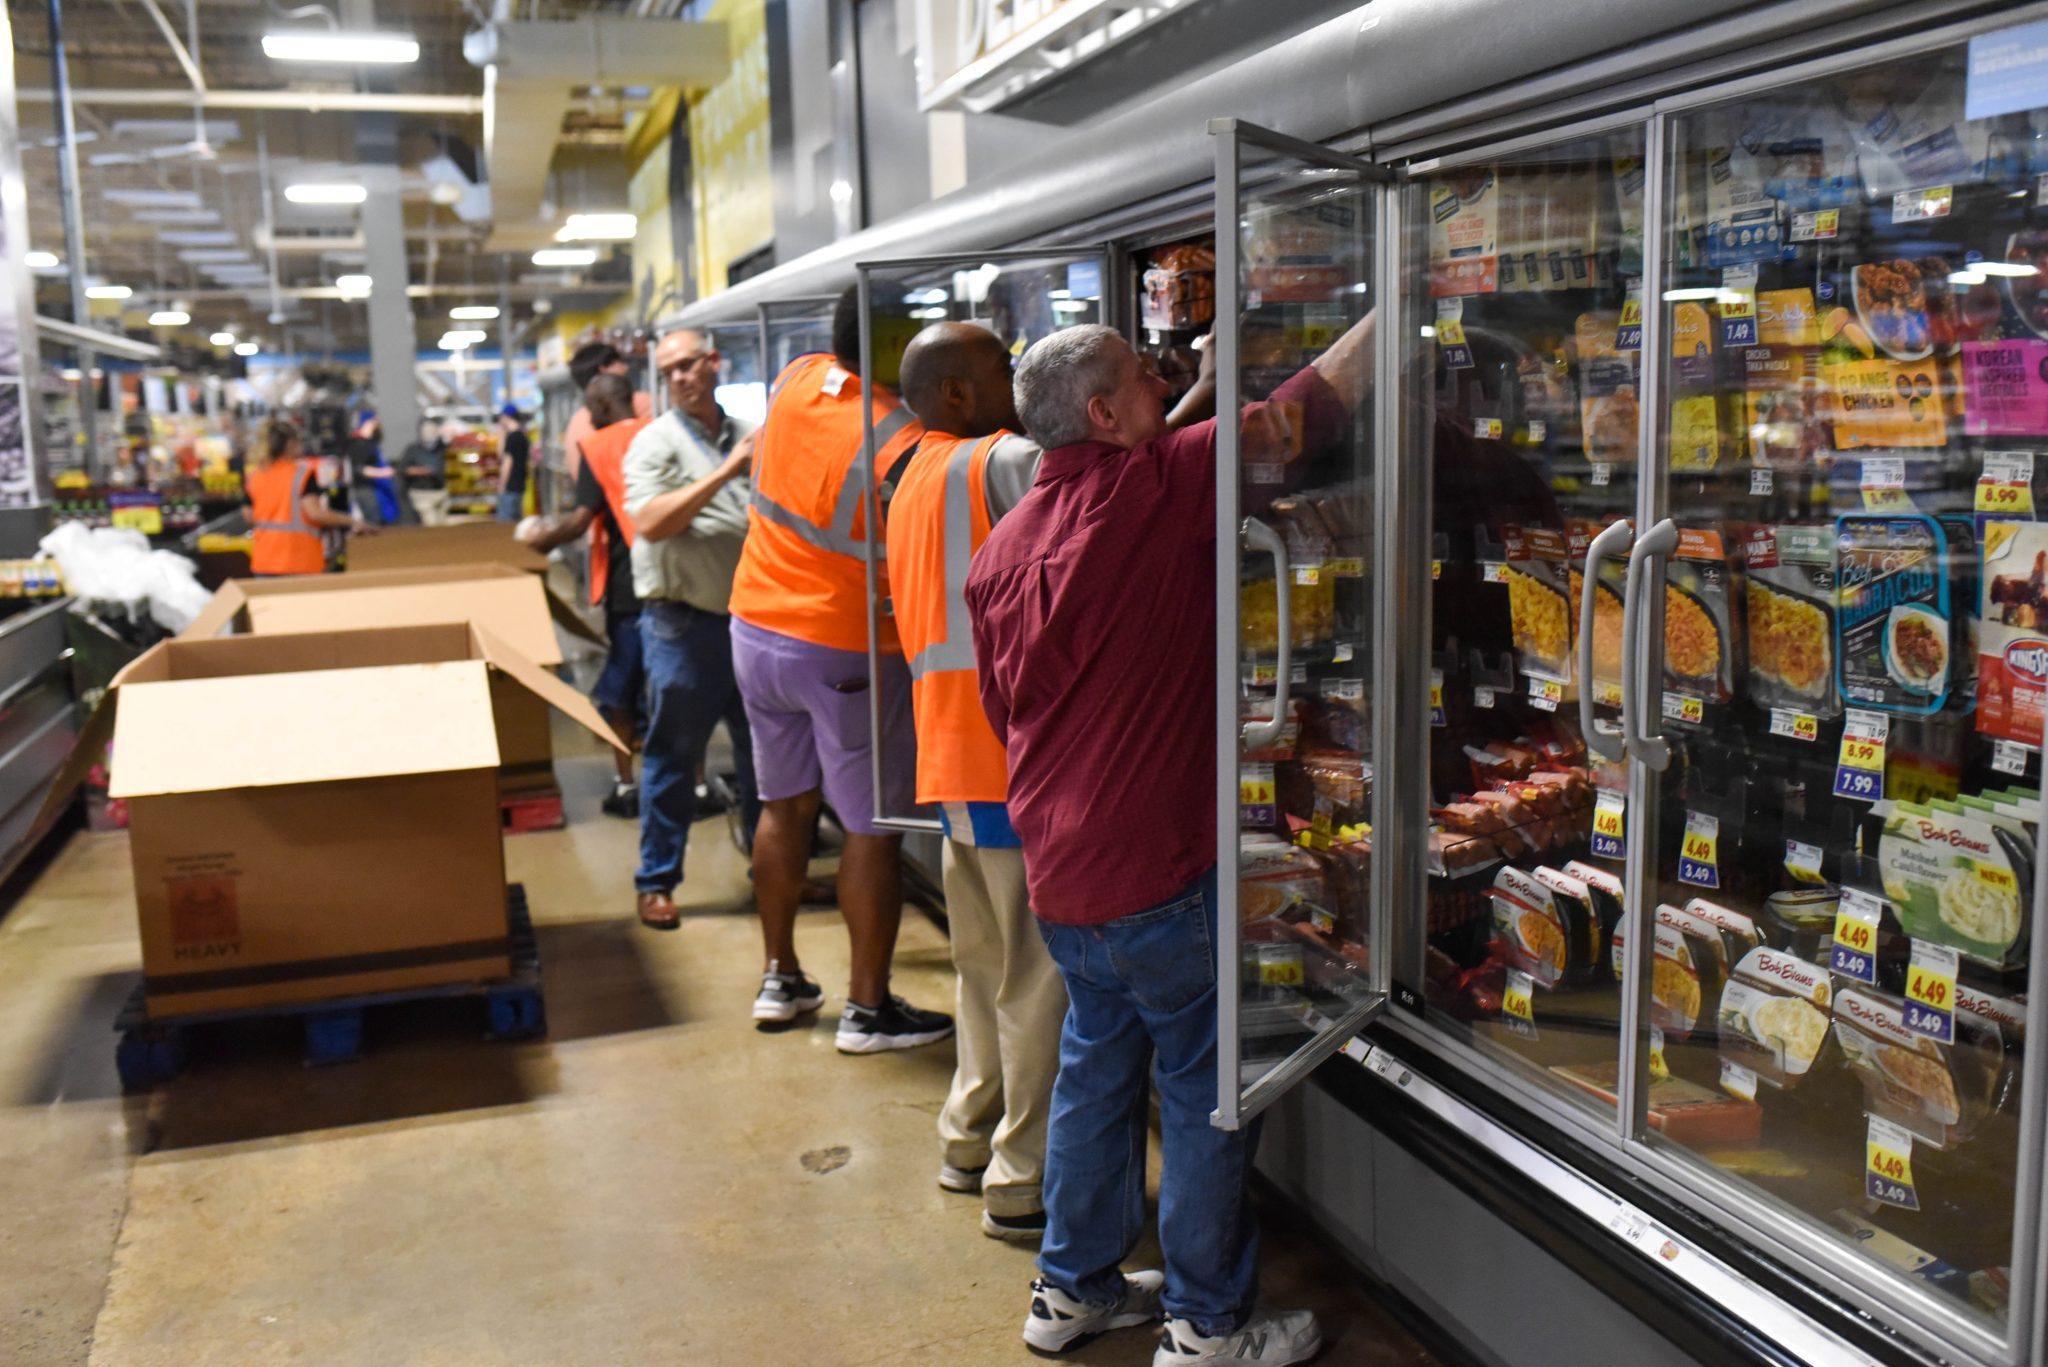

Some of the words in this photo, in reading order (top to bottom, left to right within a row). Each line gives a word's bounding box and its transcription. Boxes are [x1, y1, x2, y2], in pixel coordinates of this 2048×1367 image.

[1619, 331, 1642, 346] 7.49
[1727, 323, 1749, 340] 7.49
[1976, 348, 2023, 367] KOREAN
[1984, 488, 2018, 503] 8.99
[1840, 553, 1873, 588] Beef
[1847, 744, 1874, 760] 8.99
[1843, 773, 1873, 793] 7.99
[1597, 816, 1617, 833] 4.49
[1596, 838, 1618, 854] 3.49
[1918, 820, 1949, 843] Bob
[1949, 829, 1992, 854] Evans
[1687, 841, 1710, 859] 4.49
[1901, 848, 1939, 867] Mashed
[1685, 864, 1710, 881] 3.49
[1891, 859, 1948, 882] Cauliflower
[1980, 868, 2011, 887] NEW!
[1655, 935, 1675, 950] vans
[1840, 923, 1869, 948] 4.49
[1758, 953, 1782, 975] Bob
[1781, 964, 1814, 987] Evans
[1836, 952, 1865, 973] 3.49
[1912, 975, 1946, 1004] 4.49
[1507, 996, 1526, 1016] 4.49
[1976, 999, 2017, 1025] Evans
[1845, 998, 1874, 1021] Bob
[1873, 1011, 1913, 1039] Evans
[1909, 1008, 1942, 1033] 3.49
[1872, 1151, 1904, 1178] 4.49
[1874, 1180, 1906, 1202] 3.49
[1235, 1331, 1268, 1360] N
